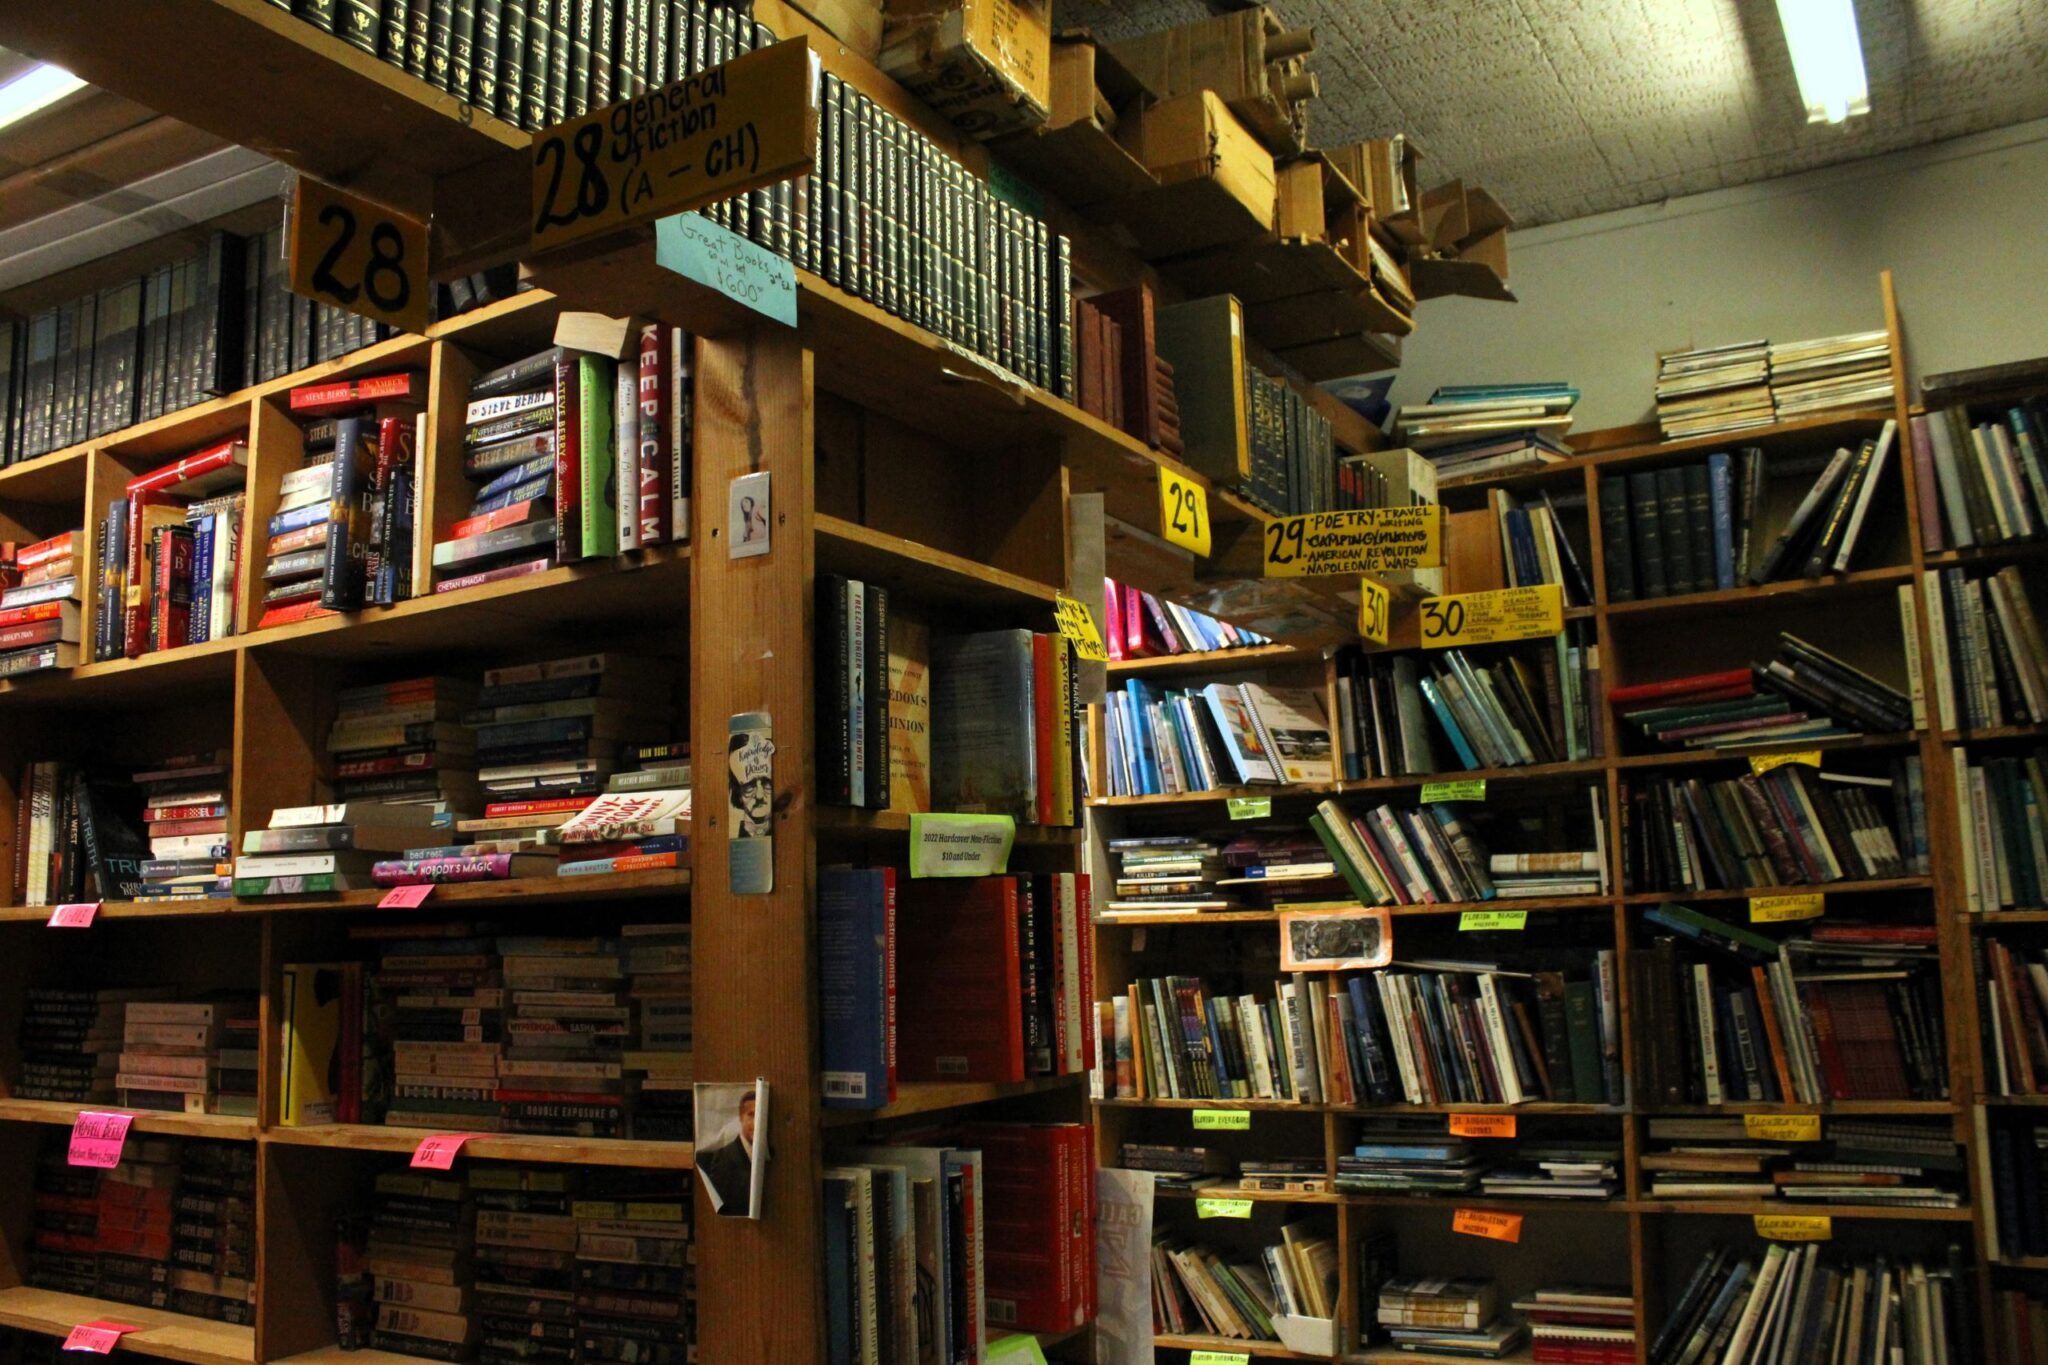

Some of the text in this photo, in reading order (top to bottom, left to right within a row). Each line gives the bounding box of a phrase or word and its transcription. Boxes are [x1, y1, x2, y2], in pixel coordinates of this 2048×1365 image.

[458, 44, 470, 57] 22
[482, 56, 495, 69] 23
[534, 66, 727, 235] 28 general
[630, 103, 717, 167] fiction
[704, 122, 760, 177] CH)
[311, 203, 411, 312] 28
[679, 212, 769, 274] Great Books
[640, 323, 658, 415] KEEP
[305, 391, 326, 401] STEVE
[327, 389, 348, 400] BERRY
[481, 392, 547, 417] STEVE BERRY
[557, 380, 567, 456] STEVE BERRY
[640, 441, 660, 542] CALM
[1169, 482, 1199, 538] 29
[1267, 507, 1432, 564] 29 POETRY TRAVEL
[1307, 542, 1428, 563] AMERICAN REVOLUTION
[437, 574, 487, 593] CHETAN BHAGAT
[1306, 557, 1418, 575] NAPOLEONIC WARS
[855, 593, 863, 638] FREEZING
[879, 593, 887, 628] LESSONS
[1365, 586, 1385, 637] 30
[1421, 599, 1465, 639] 30
[840, 629, 849, 666] OTHER
[855, 639, 863, 670] ORDER
[840, 669, 849, 712] MEANS
[879, 670, 887, 691] EDGE
[1060, 652, 1072, 748] NAVIGATE LIFE
[738, 741, 774, 763] Knowledge
[745, 763, 769, 777] Power
[70, 818, 79, 845] WEST
[83, 816, 99, 867] TRUTH
[924, 832, 938, 843] 2022
[938, 832, 969, 845] Hardcover
[409, 849, 444, 860] bed rest
[420, 861, 494, 876] NOBODY'S MAGIC
[964, 851, 981, 862] Under
[1025, 880, 1034, 889] A
[1025, 892, 1036, 927] DEATH
[1463, 912, 1491, 921] FLORIDA
[1026, 931, 1037, 946] ON
[888, 887, 897, 1069] The Destructionists Dana Milbank
[1028, 963, 1039, 1004] STREET
[561, 1105, 607, 1120] EXPOSURE
[865, 1179, 877, 1316] ABUNDANCE DEEPAK
[966, 1232, 976, 1276] DADDY
